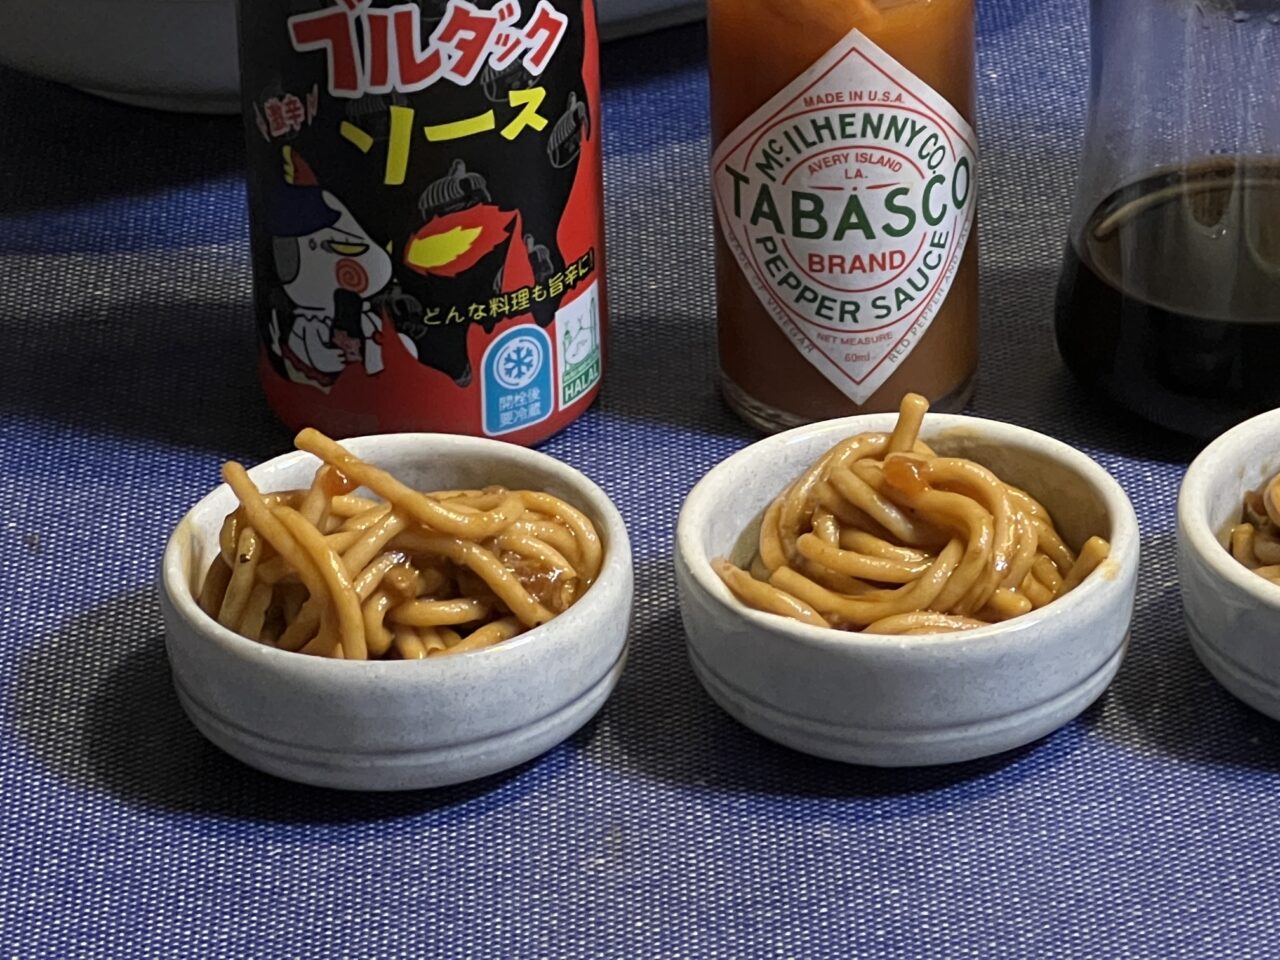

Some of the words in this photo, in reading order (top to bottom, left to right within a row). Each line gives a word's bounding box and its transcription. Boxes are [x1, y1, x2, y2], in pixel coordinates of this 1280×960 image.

[803, 92, 844, 107] MADE
[849, 91, 863, 101] IN
[340, 87, 549, 185] ソース
[808, 152, 850, 178] AVERY
[855, 152, 903, 173] ISLAND
[844, 167, 869, 179] LA.
[724, 156, 970, 242] TABASCO
[755, 235, 861, 324] PEPPER
[871, 230, 950, 321] SAUCE
[808, 250, 906, 275] BRAND
[565, 363, 599, 401] HALAL
